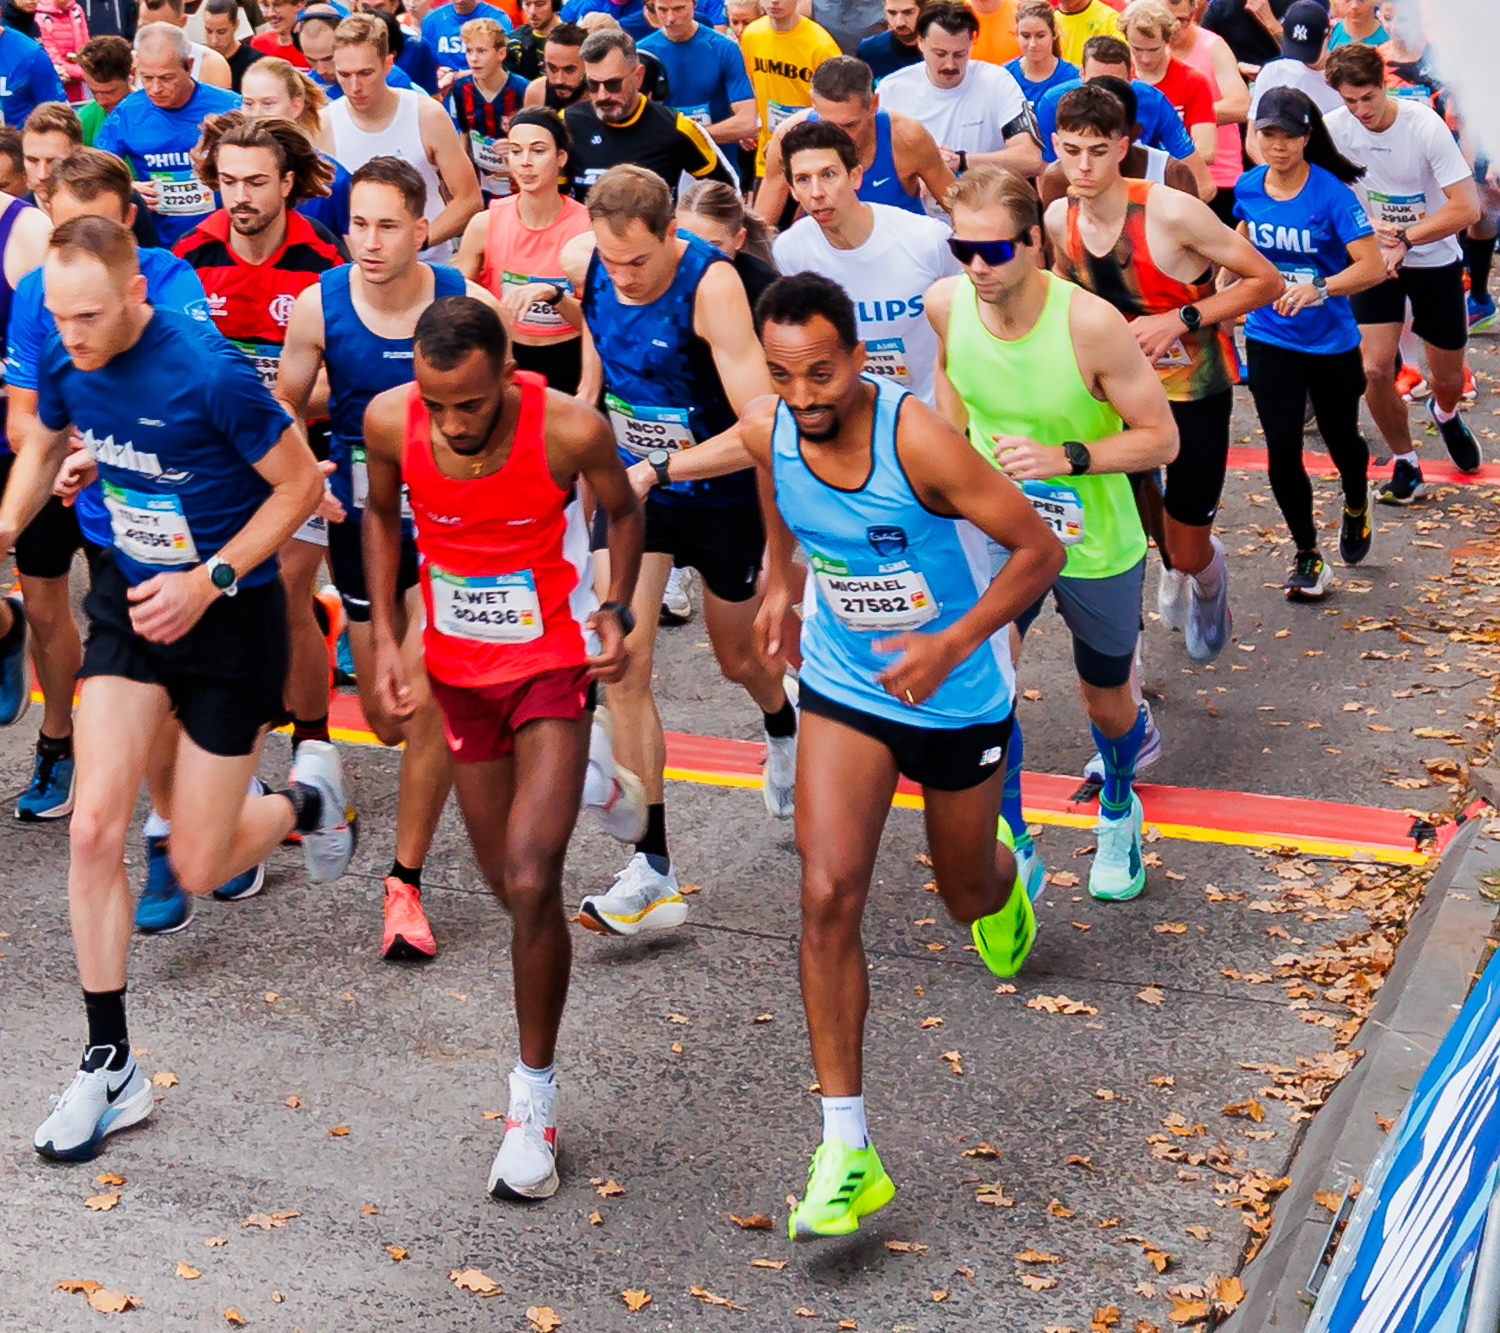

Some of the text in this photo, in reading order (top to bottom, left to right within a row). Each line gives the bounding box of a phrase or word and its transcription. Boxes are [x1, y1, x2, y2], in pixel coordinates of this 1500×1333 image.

[438, 35, 468, 54] AS
[754, 56, 813, 83] JUMBO
[163, 183, 198, 193] PETER
[163, 194, 202, 205] 27209
[1246, 221, 1319, 254] ASML
[626, 419, 667, 435] NICO
[624, 431, 679, 450] 32224
[828, 578, 907, 593] MICHAEL
[452, 589, 510, 605] AWET
[840, 596, 911, 614] 27582
[450, 603, 519, 625] 30436
